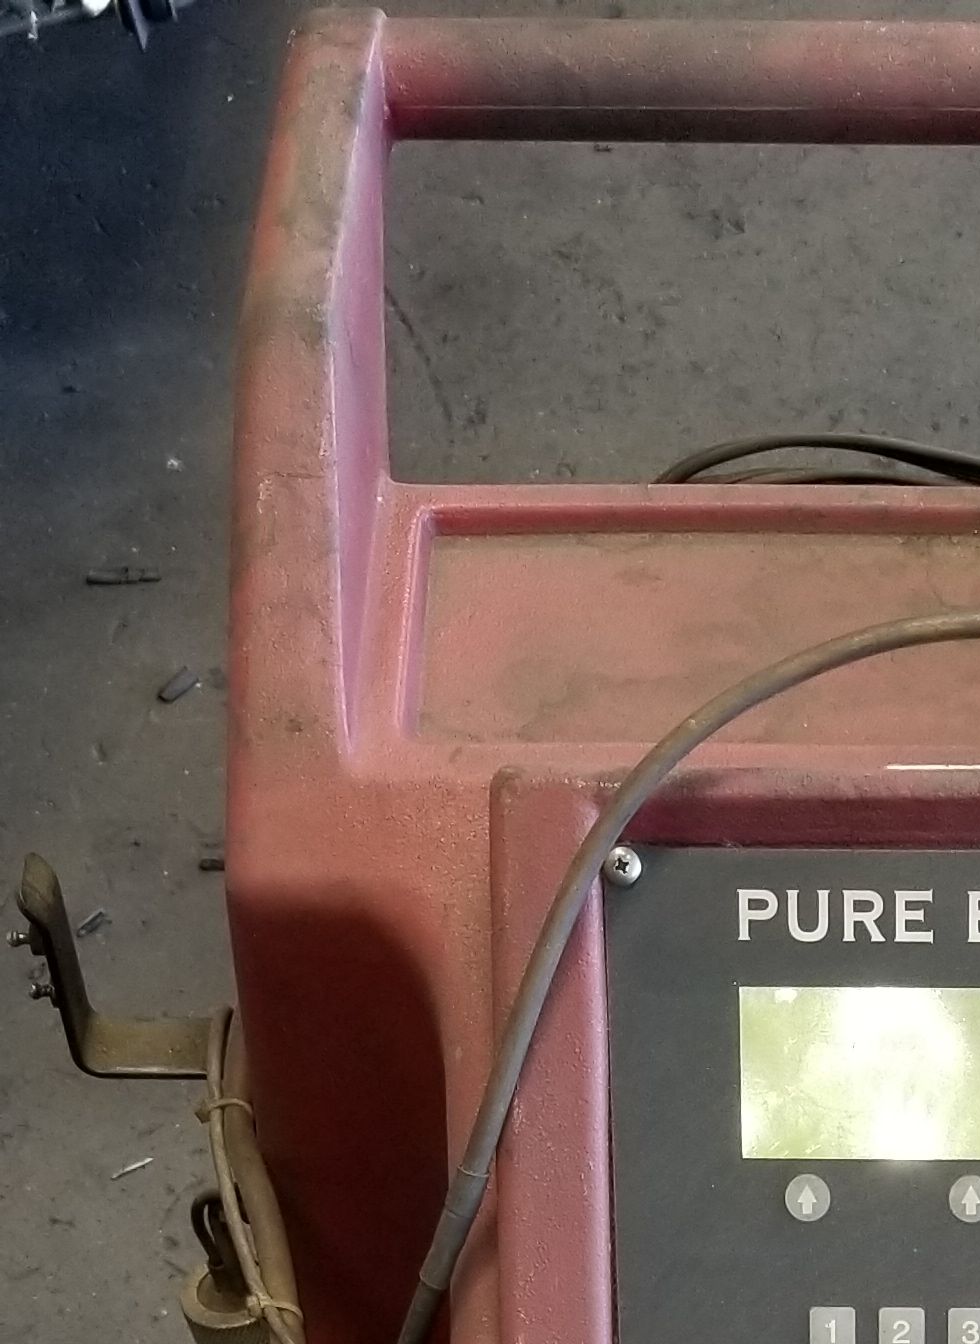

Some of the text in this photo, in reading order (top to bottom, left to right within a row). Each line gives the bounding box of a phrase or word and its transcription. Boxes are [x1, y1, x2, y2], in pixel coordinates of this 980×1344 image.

[736, 889, 934, 944] PURE
[825, 1320, 838, 1343] 1
[892, 1320, 912, 1343] 2
[961, 1320, 980, 1344] 3
